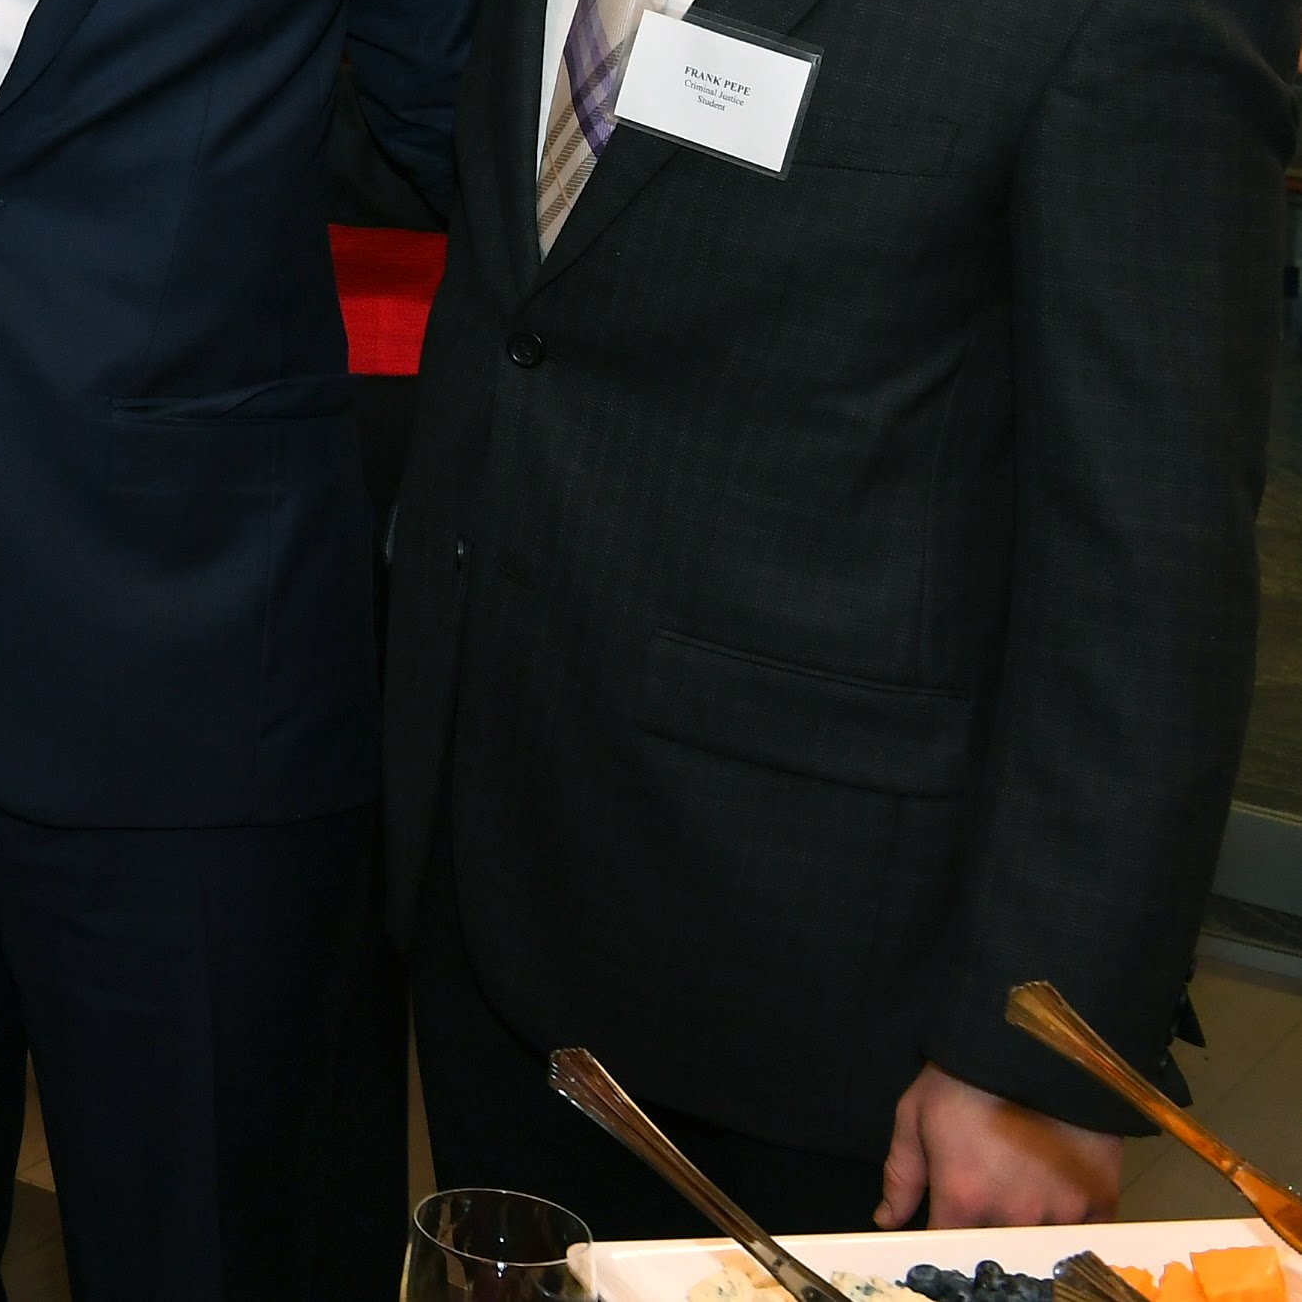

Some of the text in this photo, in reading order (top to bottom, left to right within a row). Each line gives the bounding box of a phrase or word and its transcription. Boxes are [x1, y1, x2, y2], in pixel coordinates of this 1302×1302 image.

[685, 66, 751, 96] FRANK PEPE
[685, 79, 745, 106] Criminal Justice
[697, 95, 726, 111] Student
